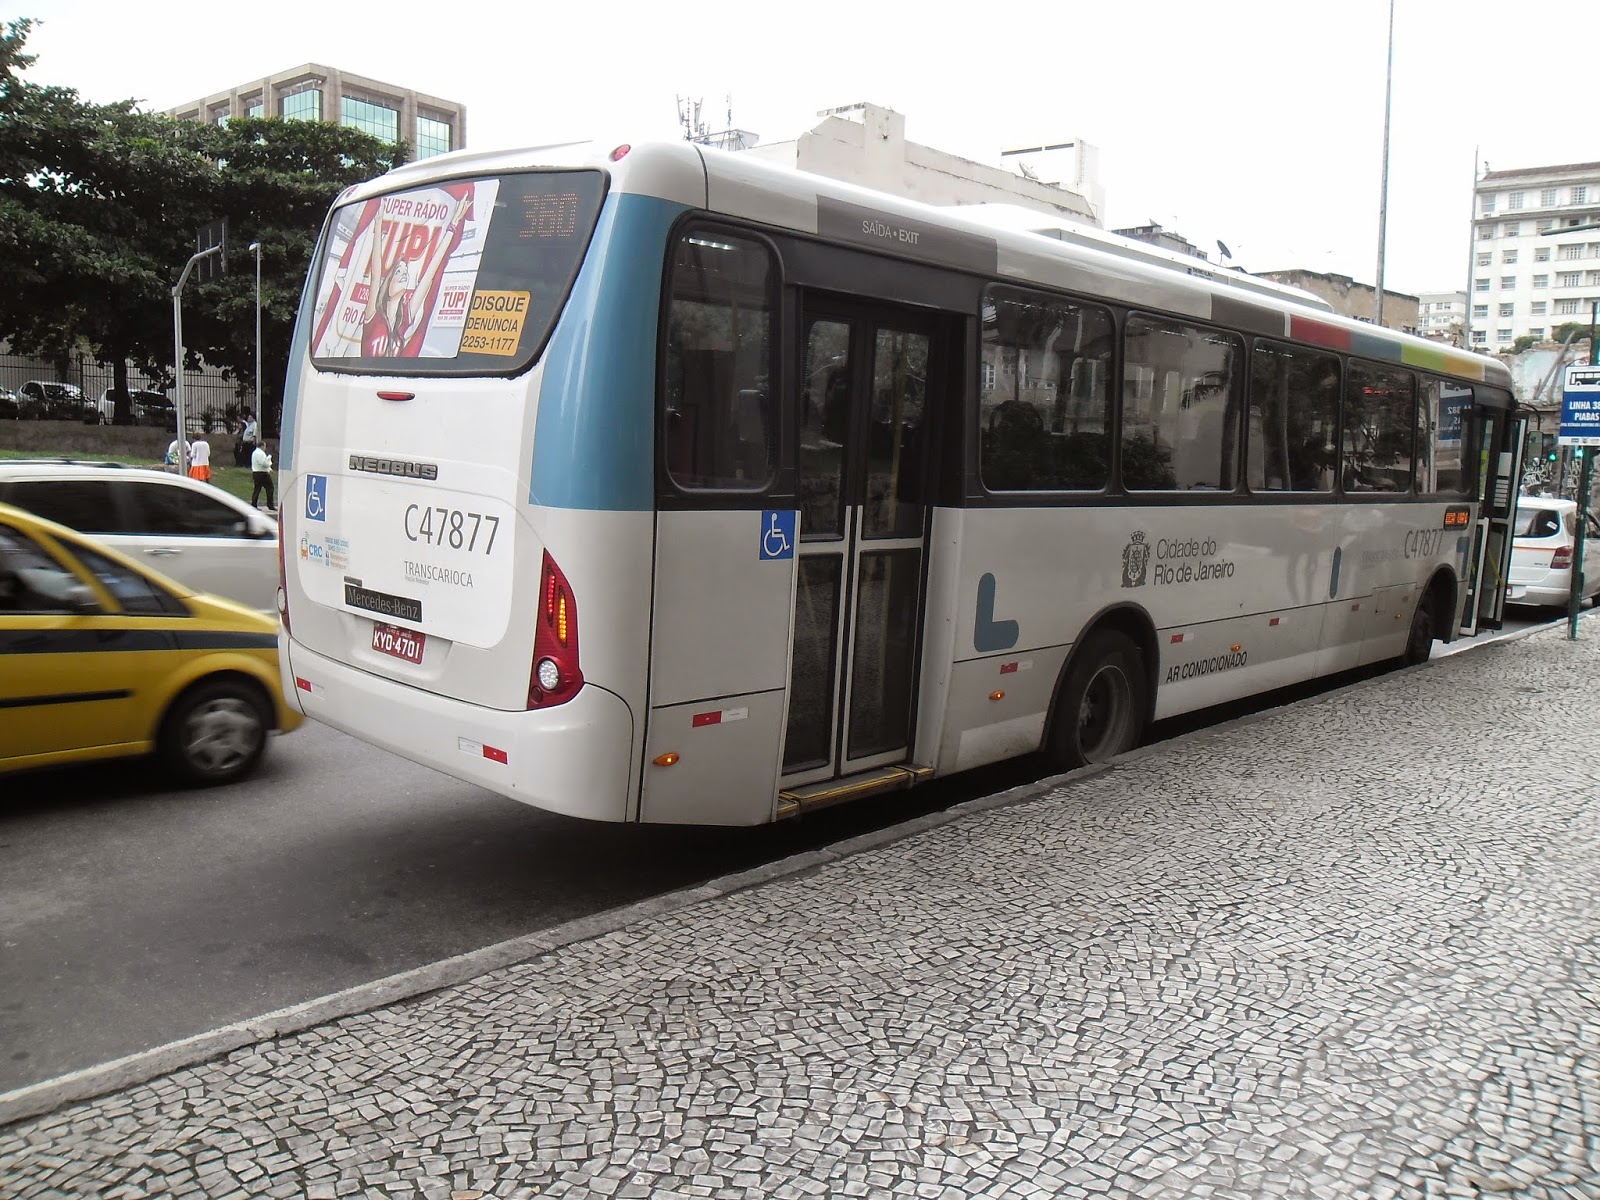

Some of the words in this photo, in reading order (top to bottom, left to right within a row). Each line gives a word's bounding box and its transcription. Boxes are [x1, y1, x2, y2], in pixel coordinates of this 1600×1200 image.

[862, 220, 892, 239] SAÍDA
[899, 229, 920, 244] EXIT
[442, 292, 468, 308] TUPI
[472, 295, 525, 312] DISQUE
[343, 307, 358, 324] RIO
[466, 315, 518, 332] DENÚNCIA
[462, 335, 515, 351] 2253-1177
[1569, 401, 1591, 410] LINHA
[1574, 412, 1600, 421] PIABAS
[349, 455, 438, 481] NEOBUS
[404, 503, 500, 555] C47877
[309, 544, 322, 558] CRC
[1156, 538, 1199, 560] Cidade
[1201, 536, 1216, 556] do
[1404, 529, 1443, 559] C47877
[404, 560, 474, 588] TRANSCARIOCA
[1153, 564, 1174, 585] Rio
[1176, 562, 1192, 583] de
[1193, 559, 1235, 581] Janeiro
[347, 587, 418, 619] Mercedes-Benz
[1166, 665, 1180, 683] AR
[1181, 651, 1248, 679] CONDICIONADO
